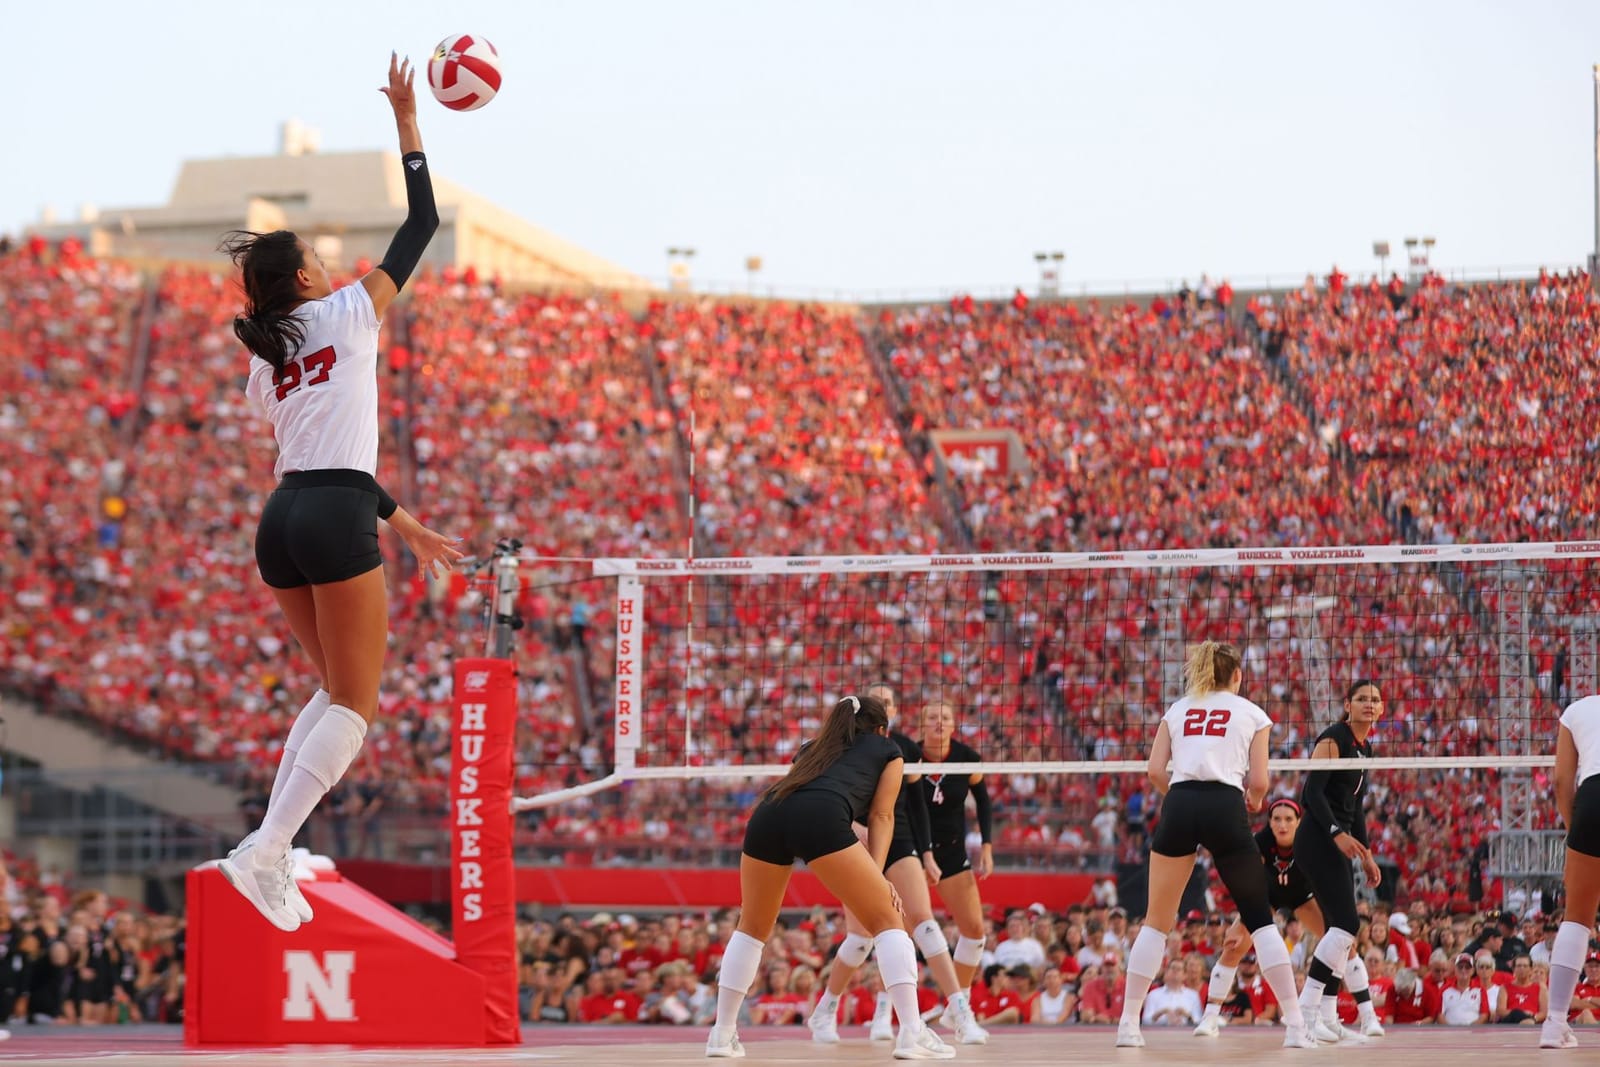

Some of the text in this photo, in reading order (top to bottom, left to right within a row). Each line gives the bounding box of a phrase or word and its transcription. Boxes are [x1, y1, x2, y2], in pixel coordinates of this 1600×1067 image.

[272, 345, 336, 402] 27
[930, 555, 1054, 565] HUSKER VOLLEYBALL
[1237, 549, 1365, 560] HUSKER VOLLEYBALL
[616, 600, 633, 736] HUSKERS
[1183, 708, 1231, 737] 22
[932, 785, 944, 805] 4
[456, 703, 487, 921] HUSKERS
[1278, 873, 1289, 886] 11
[282, 949, 357, 1021] N
